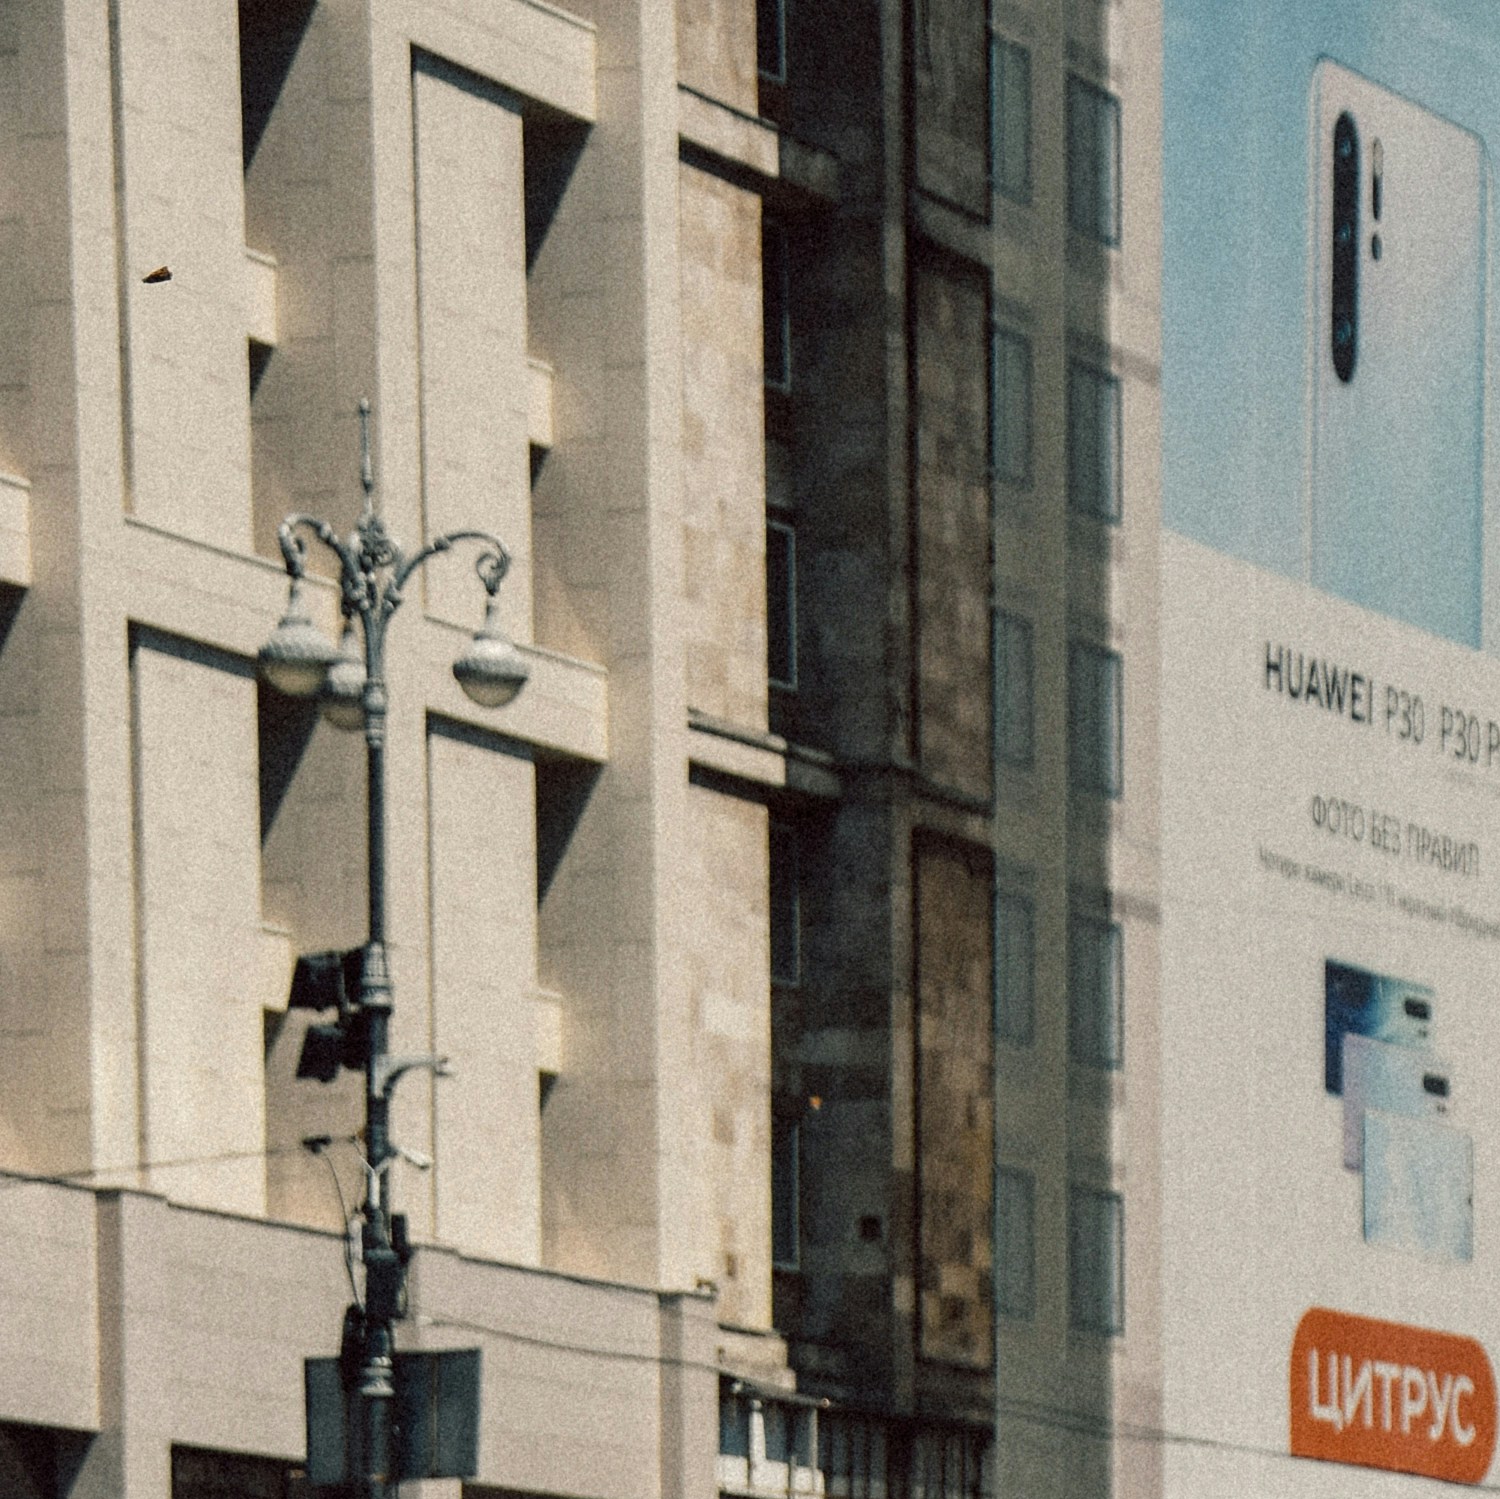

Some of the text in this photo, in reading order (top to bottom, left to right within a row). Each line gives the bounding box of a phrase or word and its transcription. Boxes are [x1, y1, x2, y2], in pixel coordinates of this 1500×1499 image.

[1265, 641, 1374, 726] HUAWEI
[1385, 685, 1425, 745] P30
[1441, 705, 1481, 764] P30
[1311, 794, 1480, 878] ФОТО БЕЗ ПРАВИЛ
[1308, 1348, 1477, 1446] ЦИТРУС
